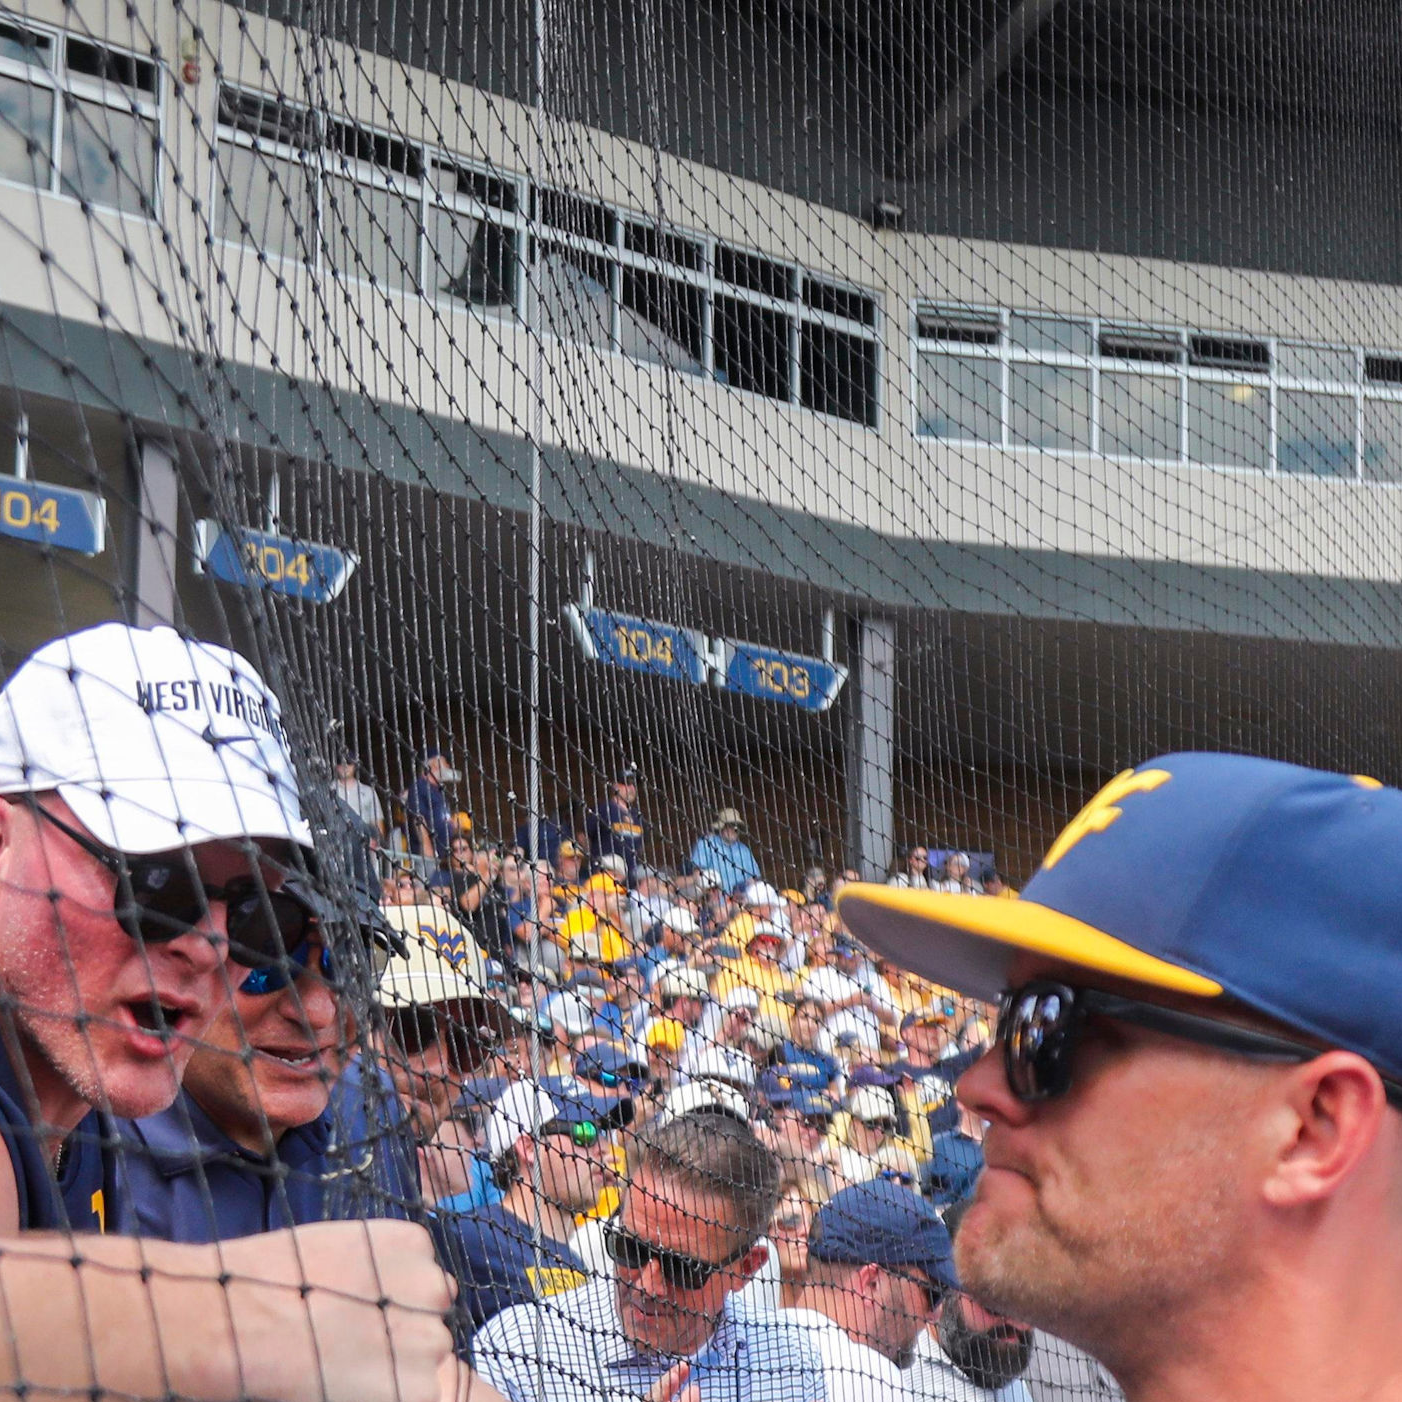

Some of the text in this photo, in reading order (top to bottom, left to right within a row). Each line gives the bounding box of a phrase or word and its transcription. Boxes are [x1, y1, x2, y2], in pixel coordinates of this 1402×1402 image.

[614, 625, 673, 667] 104
[135, 680, 201, 713] WEST
[752, 657, 811, 699] 103
